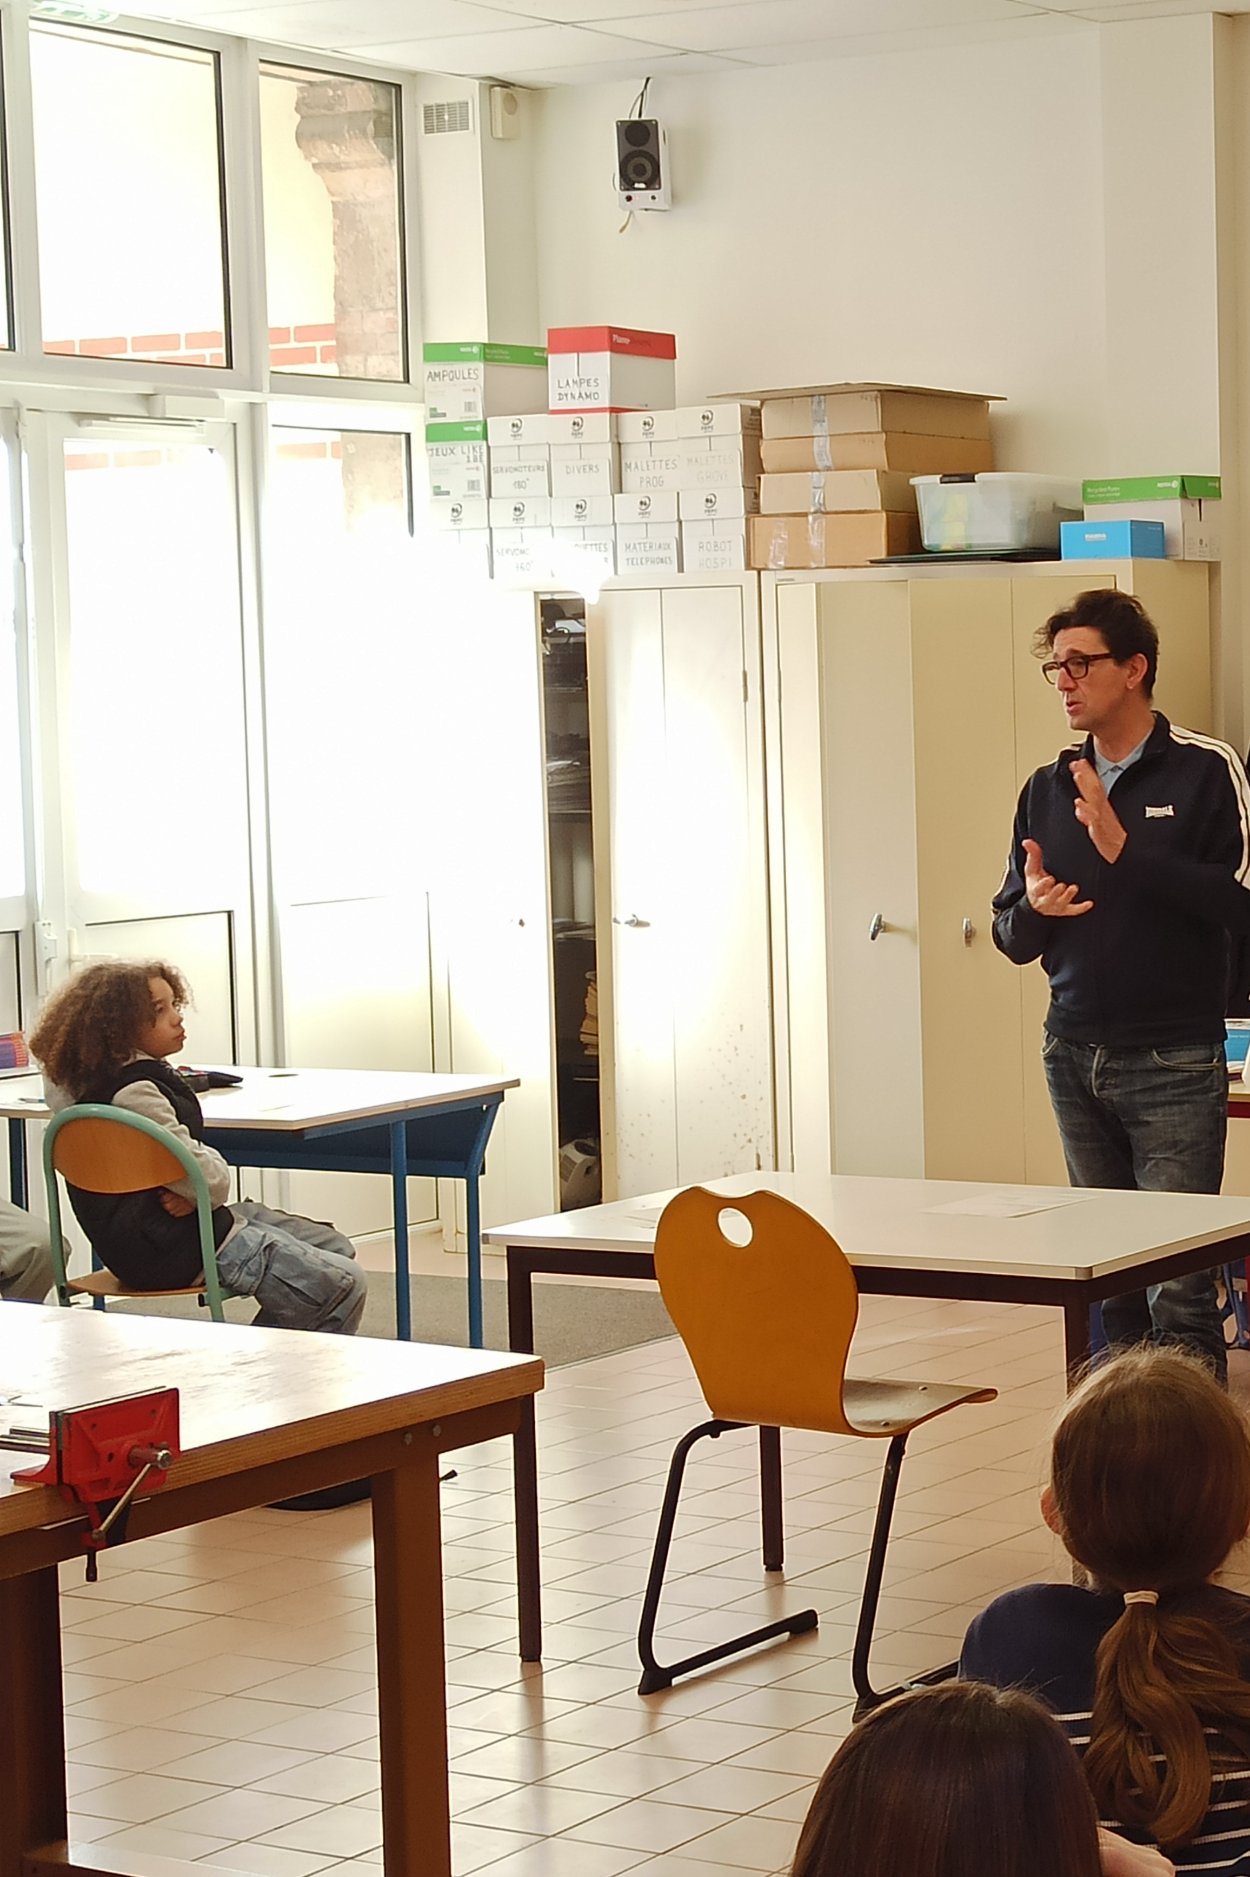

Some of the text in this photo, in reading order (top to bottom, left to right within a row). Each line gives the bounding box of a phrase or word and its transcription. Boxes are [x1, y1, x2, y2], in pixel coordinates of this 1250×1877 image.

[427, 368, 479, 382] AMPOULES
[557, 378, 600, 389] LAMPES
[557, 392, 600, 401] DYNAMO
[429, 444, 484, 457] JEUX LIKE
[566, 464, 600, 475] DIVERS
[624, 459, 678, 472] MALETTES
[640, 476, 664, 488] PROG
[699, 540, 732, 552] ROBOT
